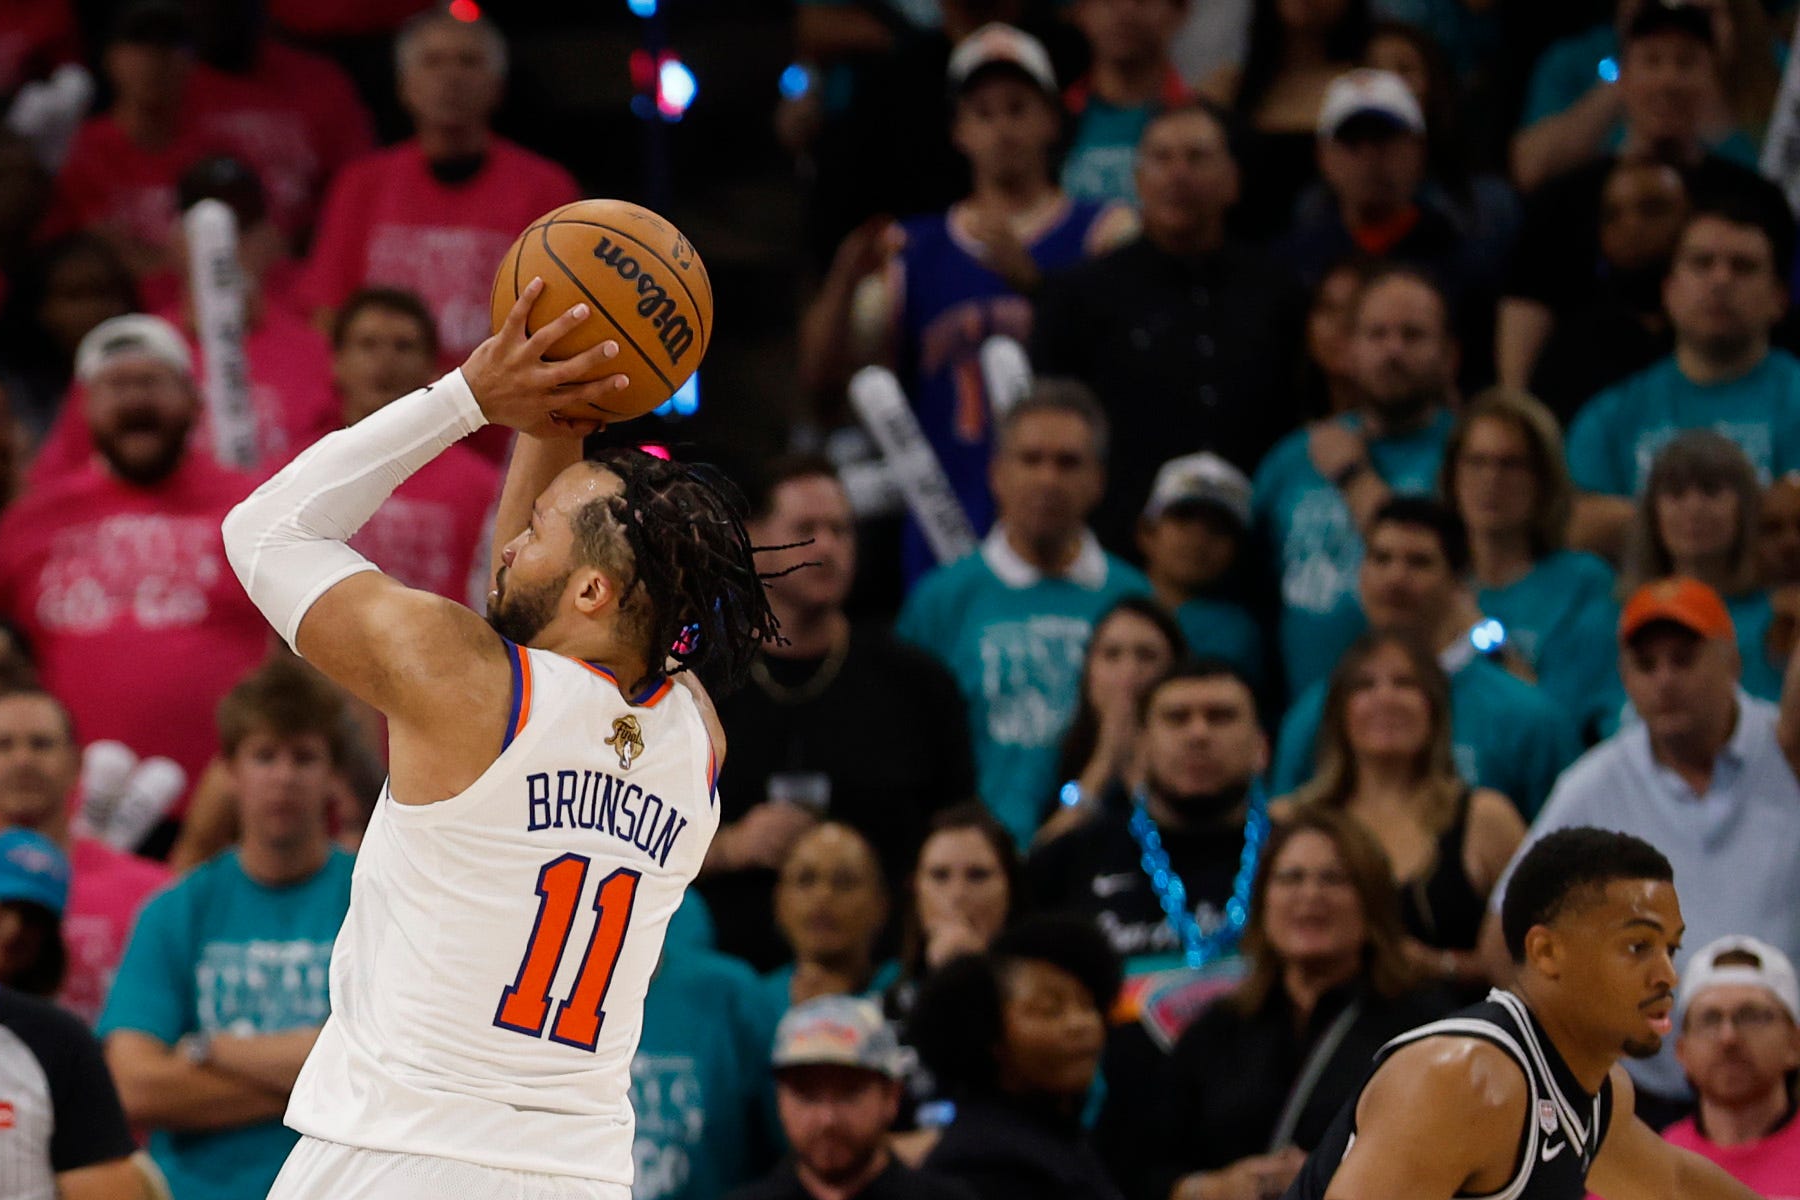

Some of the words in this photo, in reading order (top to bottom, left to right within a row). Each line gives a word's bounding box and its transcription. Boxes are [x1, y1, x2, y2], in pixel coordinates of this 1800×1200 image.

[594, 236, 694, 366] Wilson
[526, 770, 688, 868] BRUNSON
[492, 852, 643, 1053] 11
